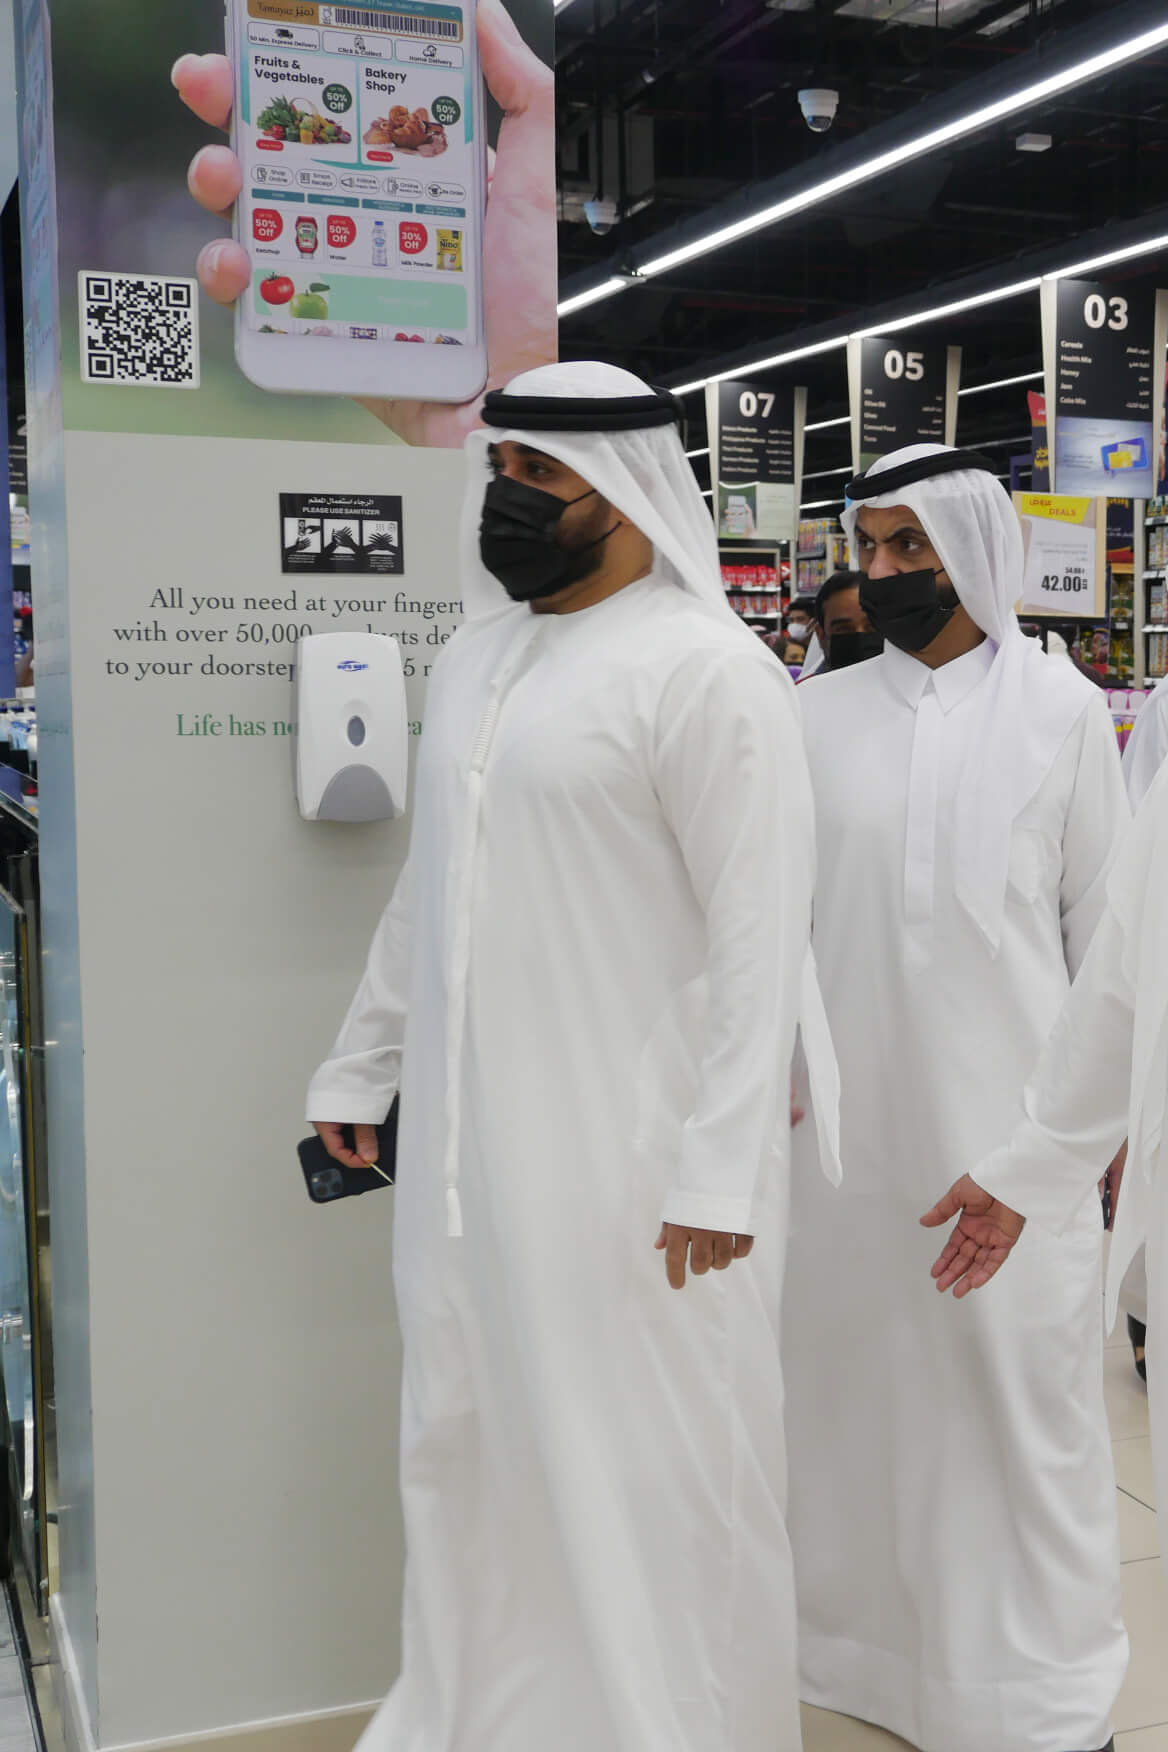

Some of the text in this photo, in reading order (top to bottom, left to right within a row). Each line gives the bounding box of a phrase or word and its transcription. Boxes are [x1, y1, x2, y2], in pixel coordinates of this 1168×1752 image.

[255, 55, 300, 70] Fruits &
[255, 68, 324, 86] Vegetables
[366, 67, 407, 82] Bakery
[366, 81, 396, 95] Shop
[327, 92, 347, 103] 50%
[330, 101, 344, 111] Off
[435, 104, 456, 116] 50%
[439, 113, 454, 124] Off
[255, 219, 277, 229] 50%
[329, 225, 350, 235] 50%
[258, 228, 274, 237] Off
[332, 234, 347, 243] Off
[401, 232, 422, 242] 30%
[404, 240, 420, 249] Off
[1084, 294, 1128, 331] 03
[884, 349, 924, 381] 05
[1060, 369, 1080, 378] Honey
[739, 391, 775, 418] 07
[1049, 508, 1076, 517] DEALS
[1041, 575, 1081, 592] 42.00
[149, 588, 464, 619] All you need at your fingert
[113, 620, 167, 642] with
[176, 627, 229, 643] over
[106, 659, 129, 676] to
[135, 661, 193, 681] your
[176, 713, 222, 737] Life
[229, 715, 266, 737] has
